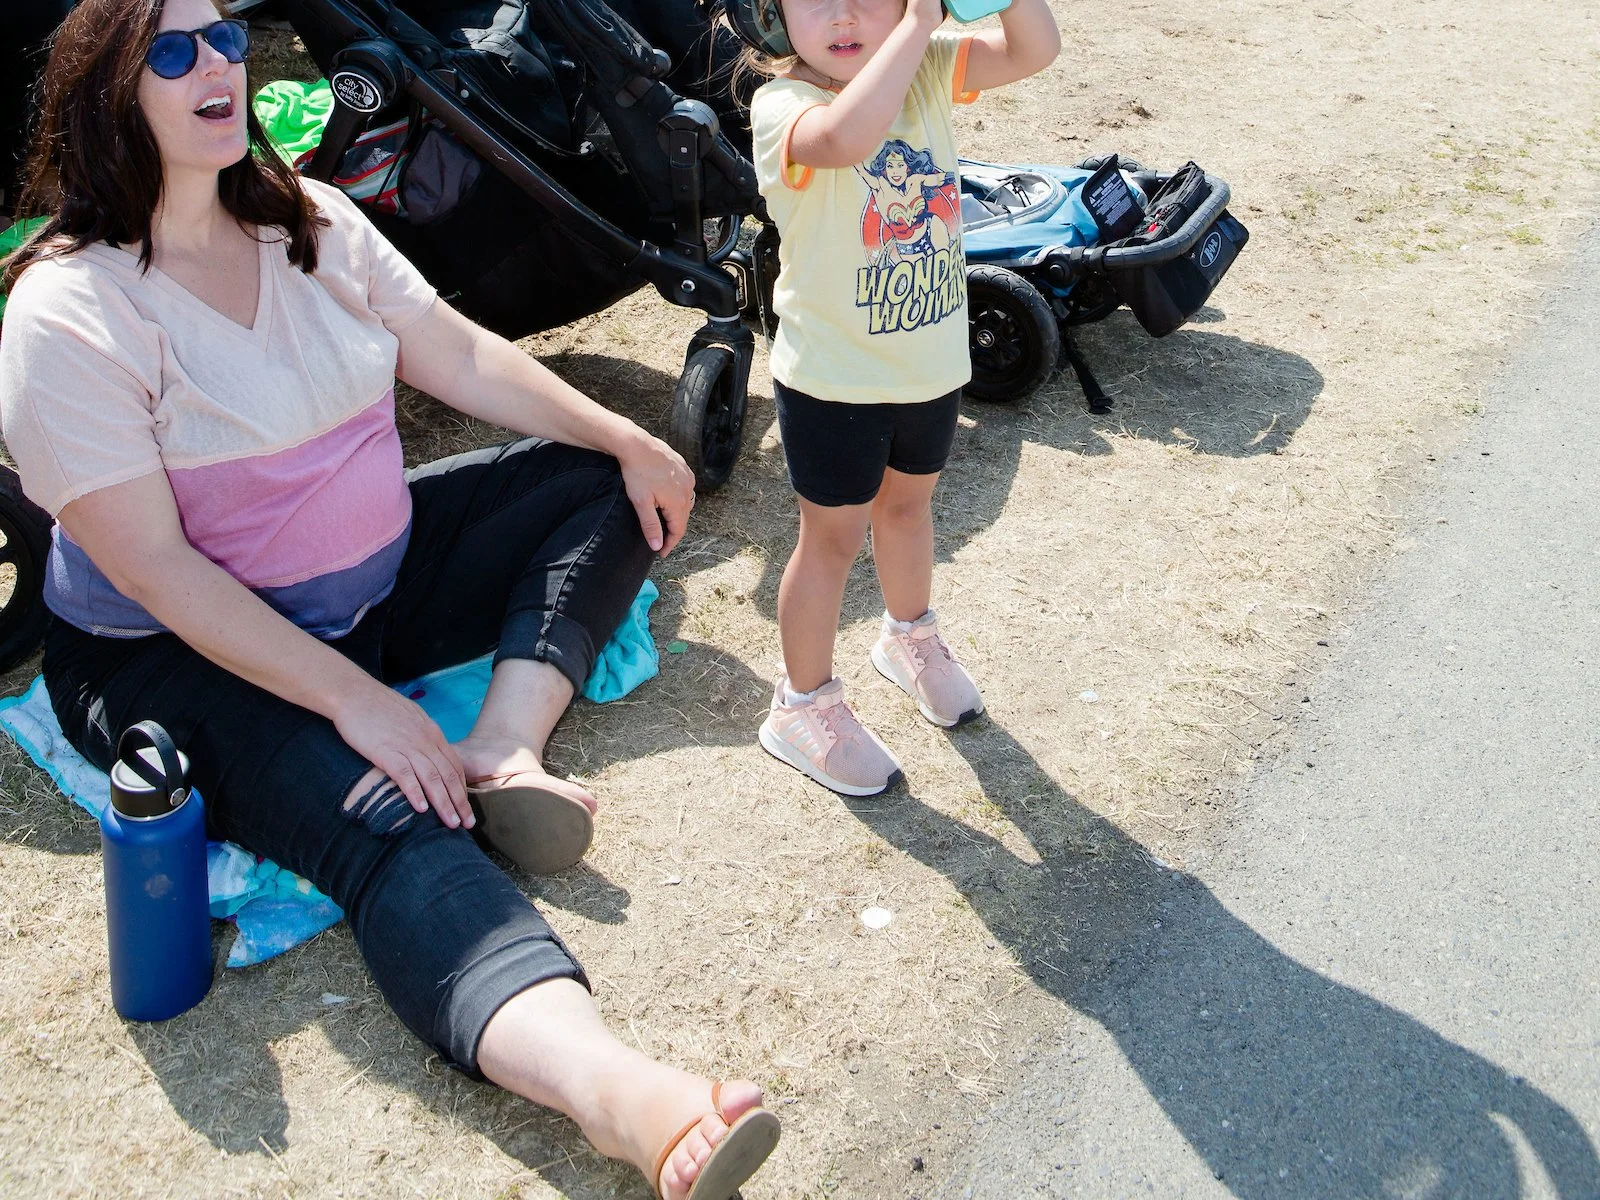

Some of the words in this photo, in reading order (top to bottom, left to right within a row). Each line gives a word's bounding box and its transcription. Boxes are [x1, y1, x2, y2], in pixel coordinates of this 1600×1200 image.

[337, 83, 362, 100] select
[344, 78, 359, 91] city
[868, 258, 967, 335] WOMAN
